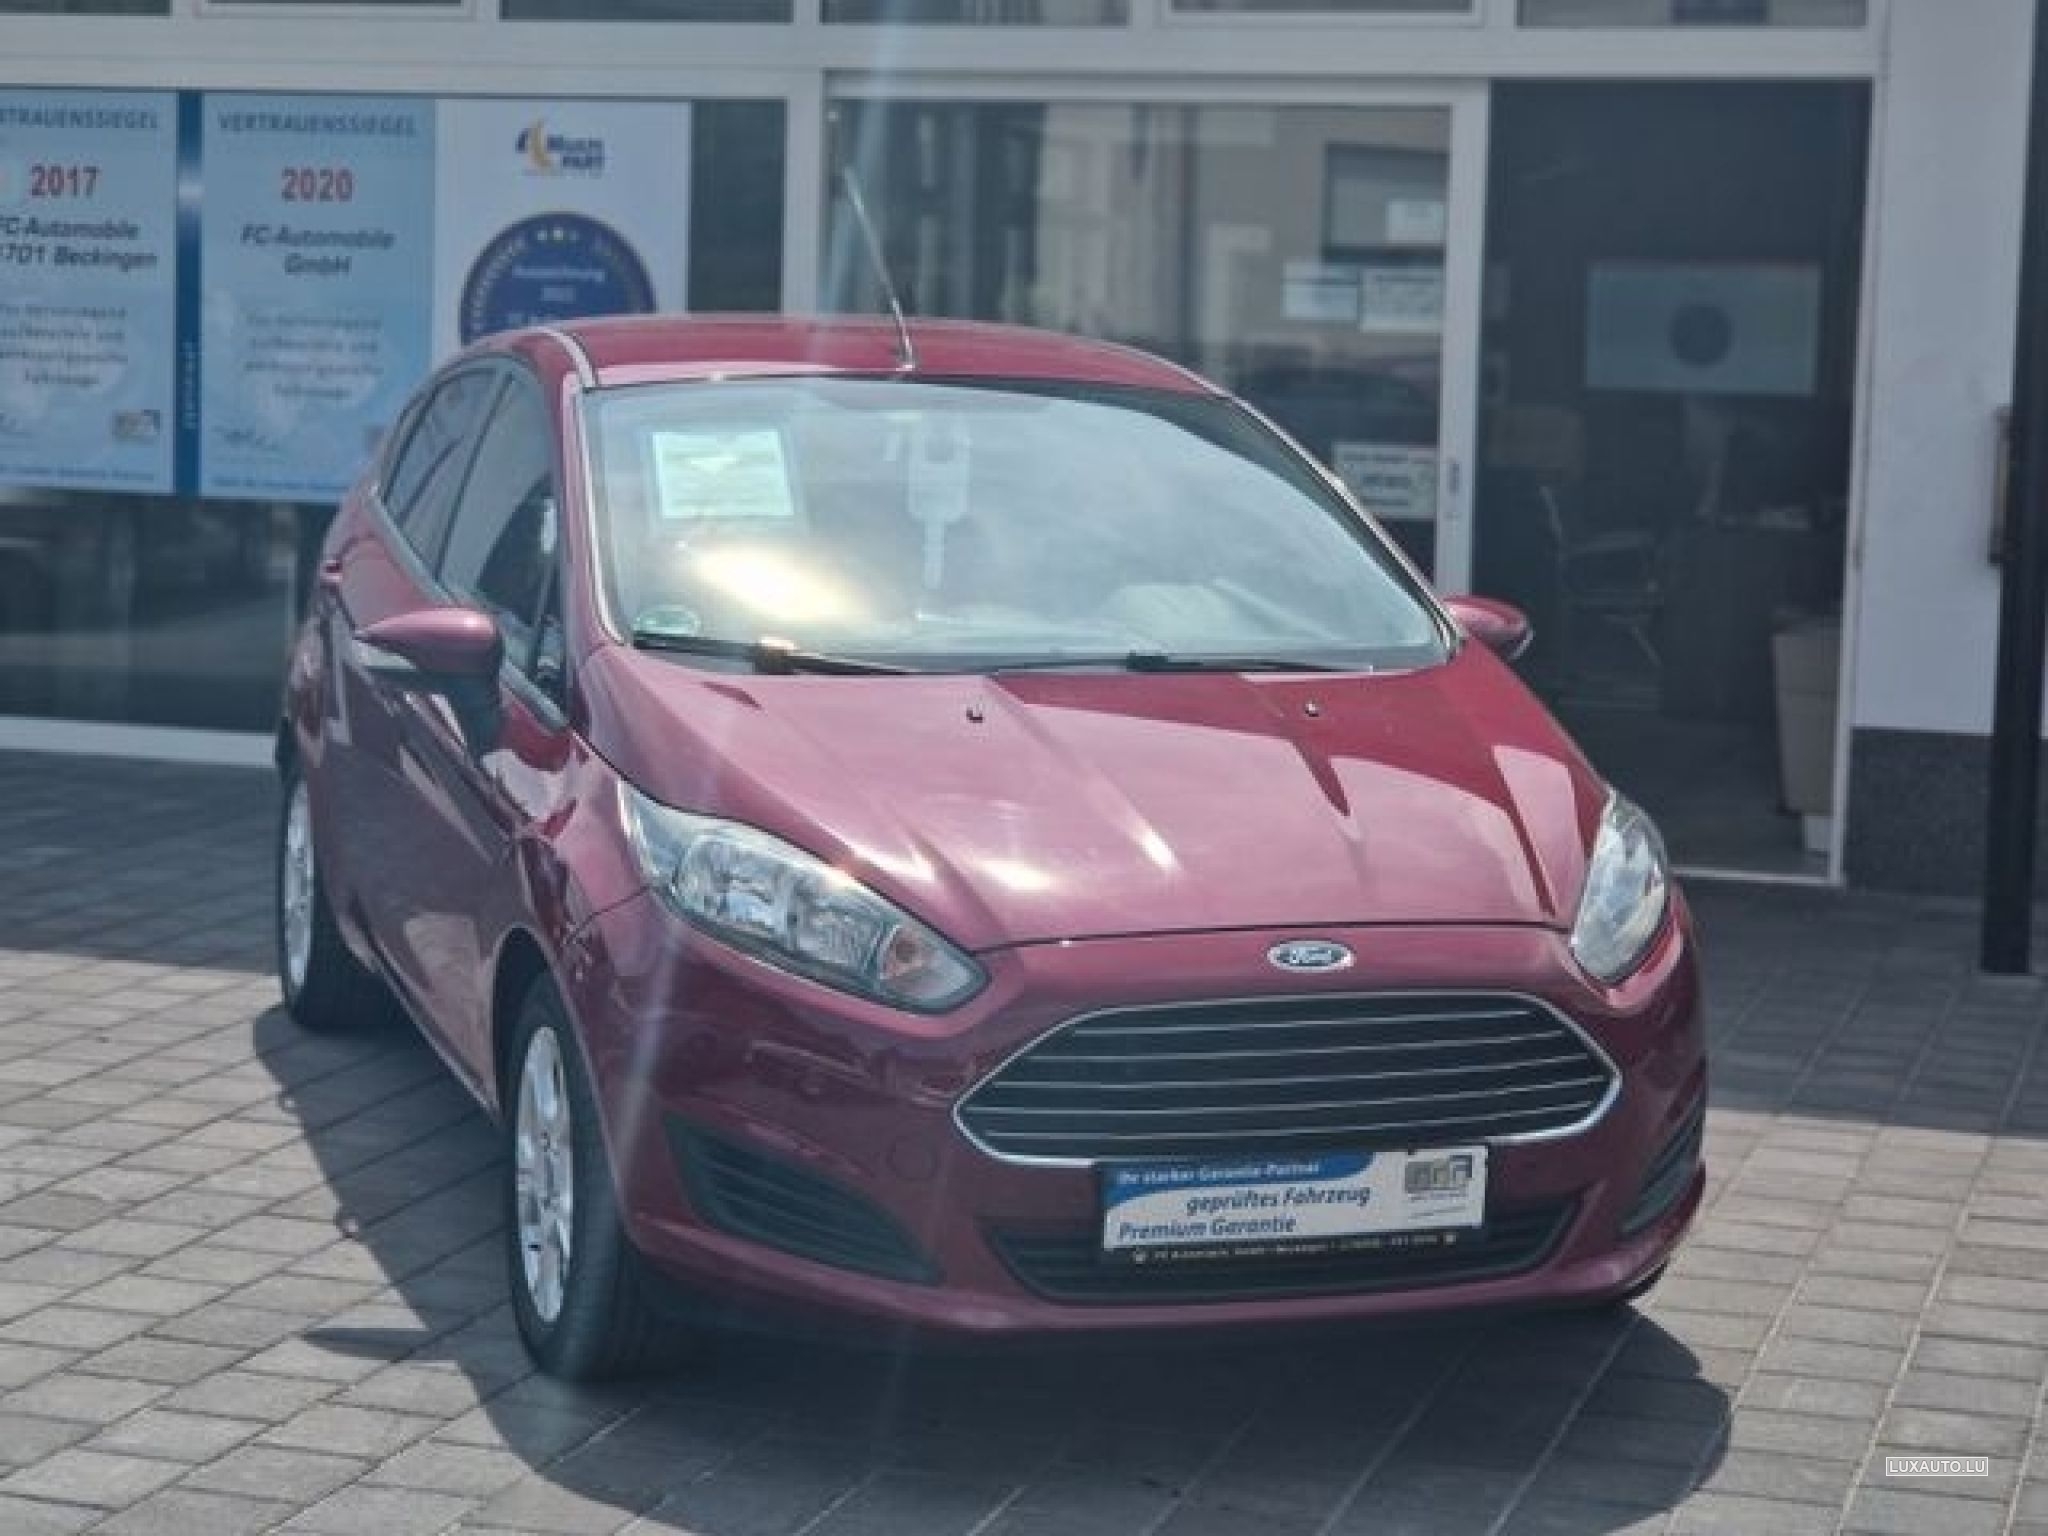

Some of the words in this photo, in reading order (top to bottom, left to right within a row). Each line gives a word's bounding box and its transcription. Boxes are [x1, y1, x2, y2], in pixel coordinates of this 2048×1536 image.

[30, 165, 99, 198] 2017
[282, 168, 353, 202] 2020
[54, 246, 157, 272] Beckingen
[1279, 946, 1342, 967] Ford
[1187, 1190, 1279, 1216] geprüftes
[1283, 1186, 1371, 1207] Fahrzeug
[1119, 1221, 1207, 1240] Premium
[1212, 1216, 1297, 1236] Garantie
